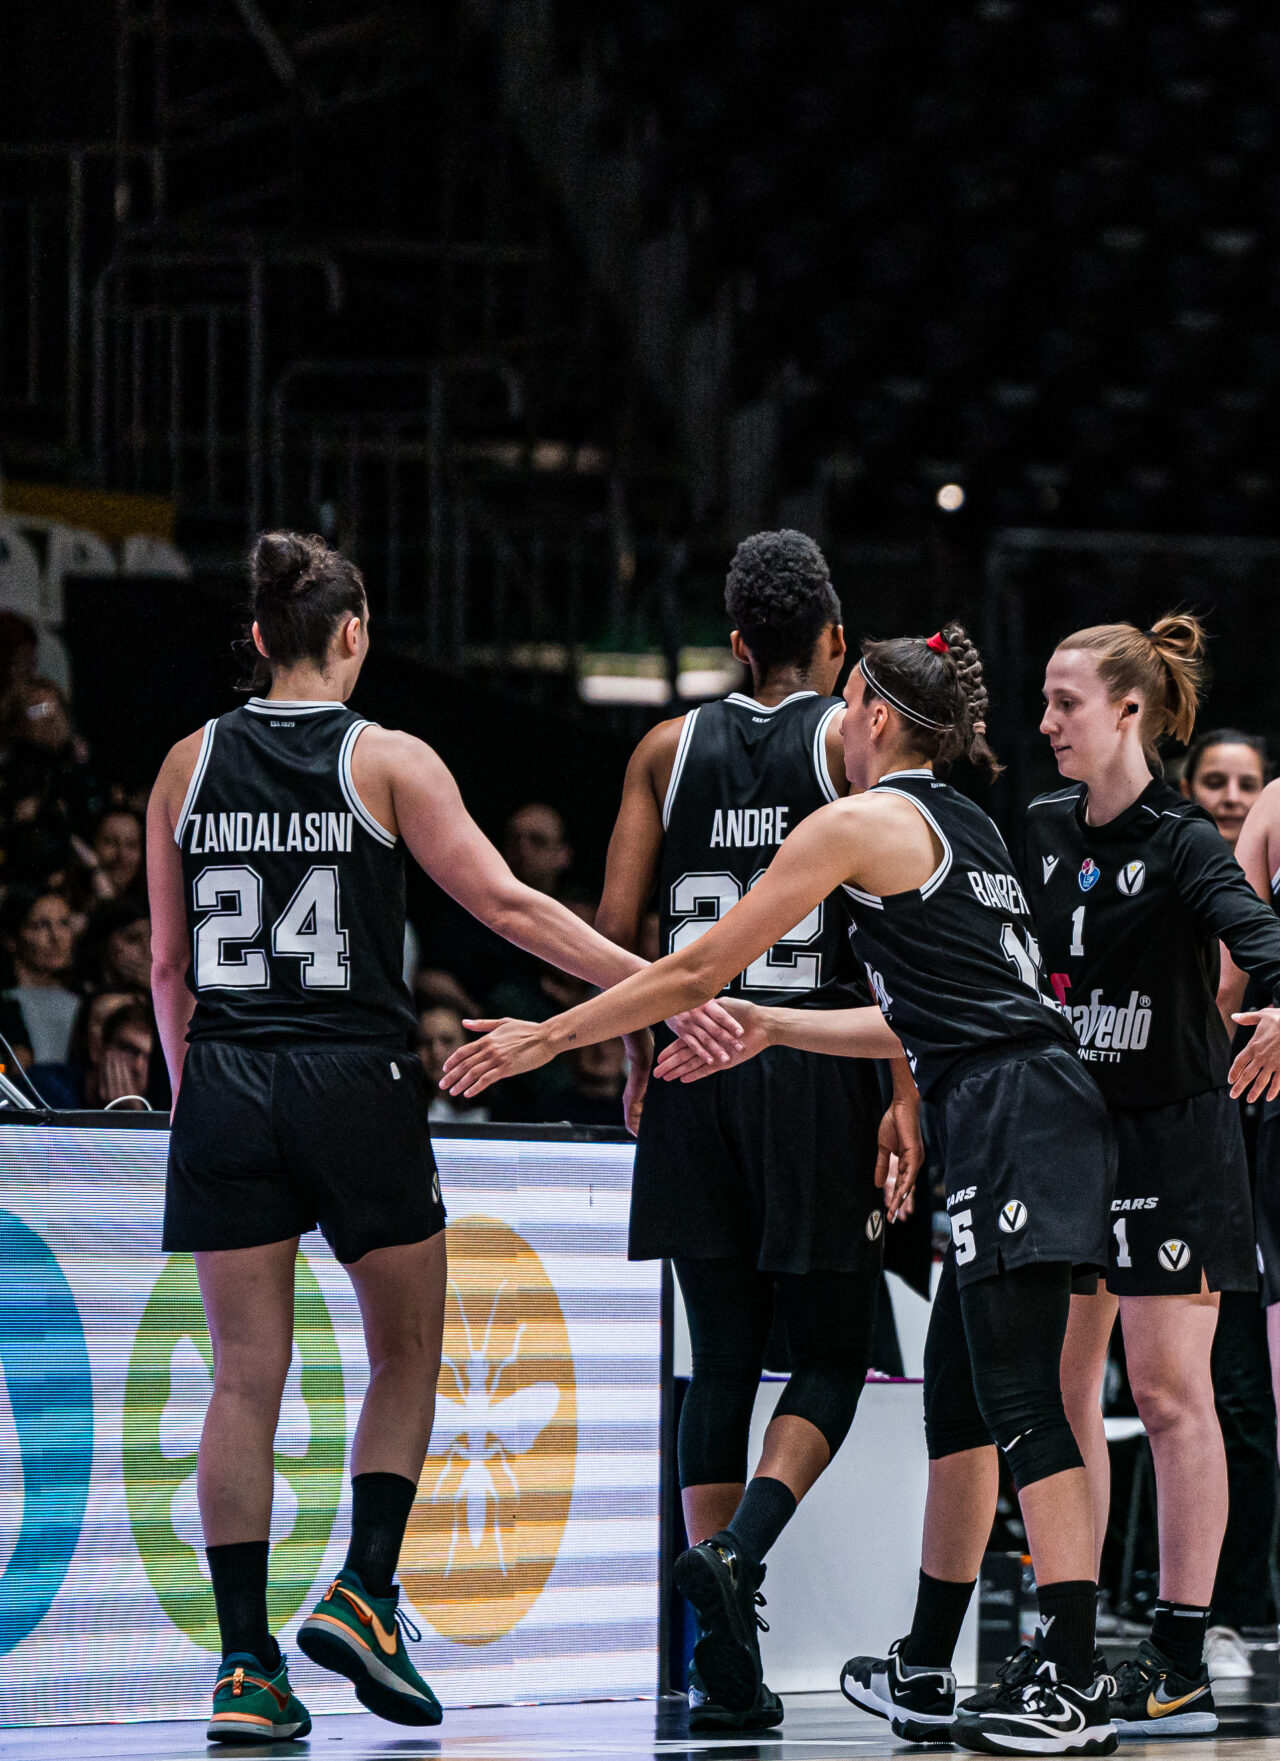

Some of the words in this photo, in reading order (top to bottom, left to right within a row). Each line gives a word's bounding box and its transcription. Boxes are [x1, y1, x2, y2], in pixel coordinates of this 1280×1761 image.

[189, 812, 353, 854] ZANDALASINI
[710, 806, 789, 848] ANDRE
[193, 865, 350, 991] 24
[669, 868, 824, 992] 22
[1069, 905, 1086, 956] 1
[1078, 1049, 1121, 1063] NETTI
[1110, 1197, 1159, 1211] CARS
[950, 1208, 977, 1267] 5
[1112, 1217, 1133, 1268] 1
